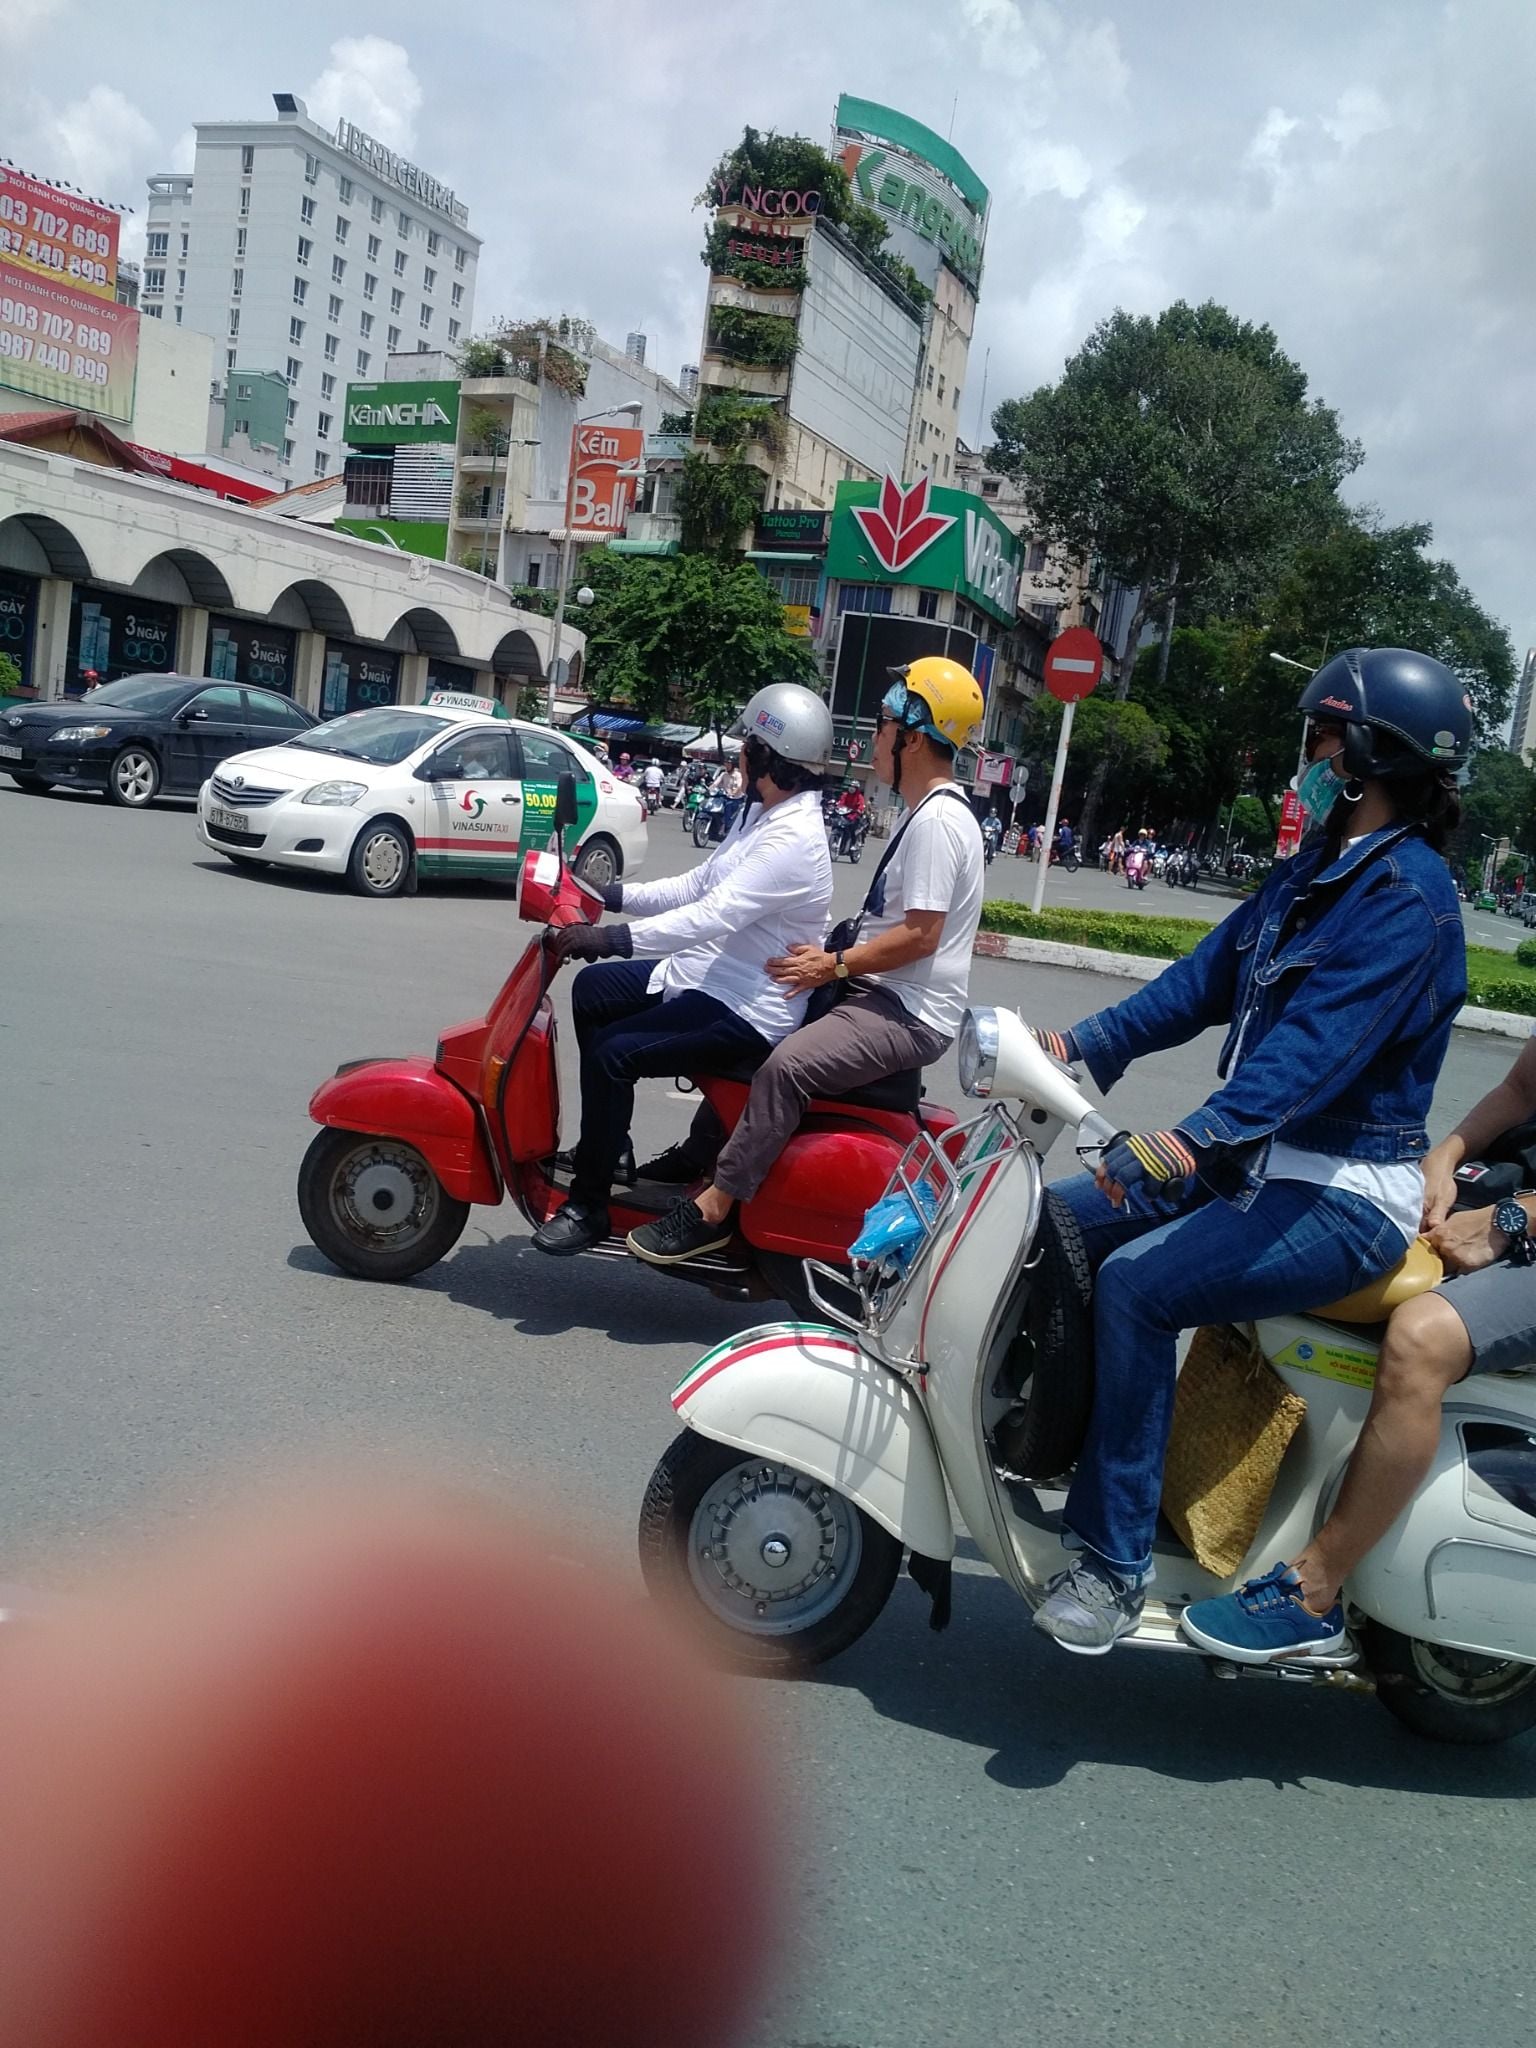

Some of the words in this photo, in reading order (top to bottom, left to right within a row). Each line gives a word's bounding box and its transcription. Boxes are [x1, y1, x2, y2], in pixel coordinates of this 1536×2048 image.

[338, 116, 399, 180] LIBERTY
[396, 157, 456, 216] CENTRAL
[51, 195, 68, 206] CHO
[32, 206, 69, 243] 702
[72, 223, 110, 257] 689
[26, 237, 65, 272] 440
[69, 254, 107, 287] 899
[51, 291, 69, 304] CHO
[0, 297, 38, 331] 903
[42, 310, 74, 344] 702
[76, 324, 111, 356] 689
[37, 342, 71, 375] 440
[74, 355, 109, 386] 899
[761, 513, 796, 528] Tattoo
[799, 514, 819, 529] Pro
[124, 614, 136, 636] 3
[250, 639, 260, 660] 3
[360, 661, 368, 680] 3
[525, 792, 558, 808] 50.00
